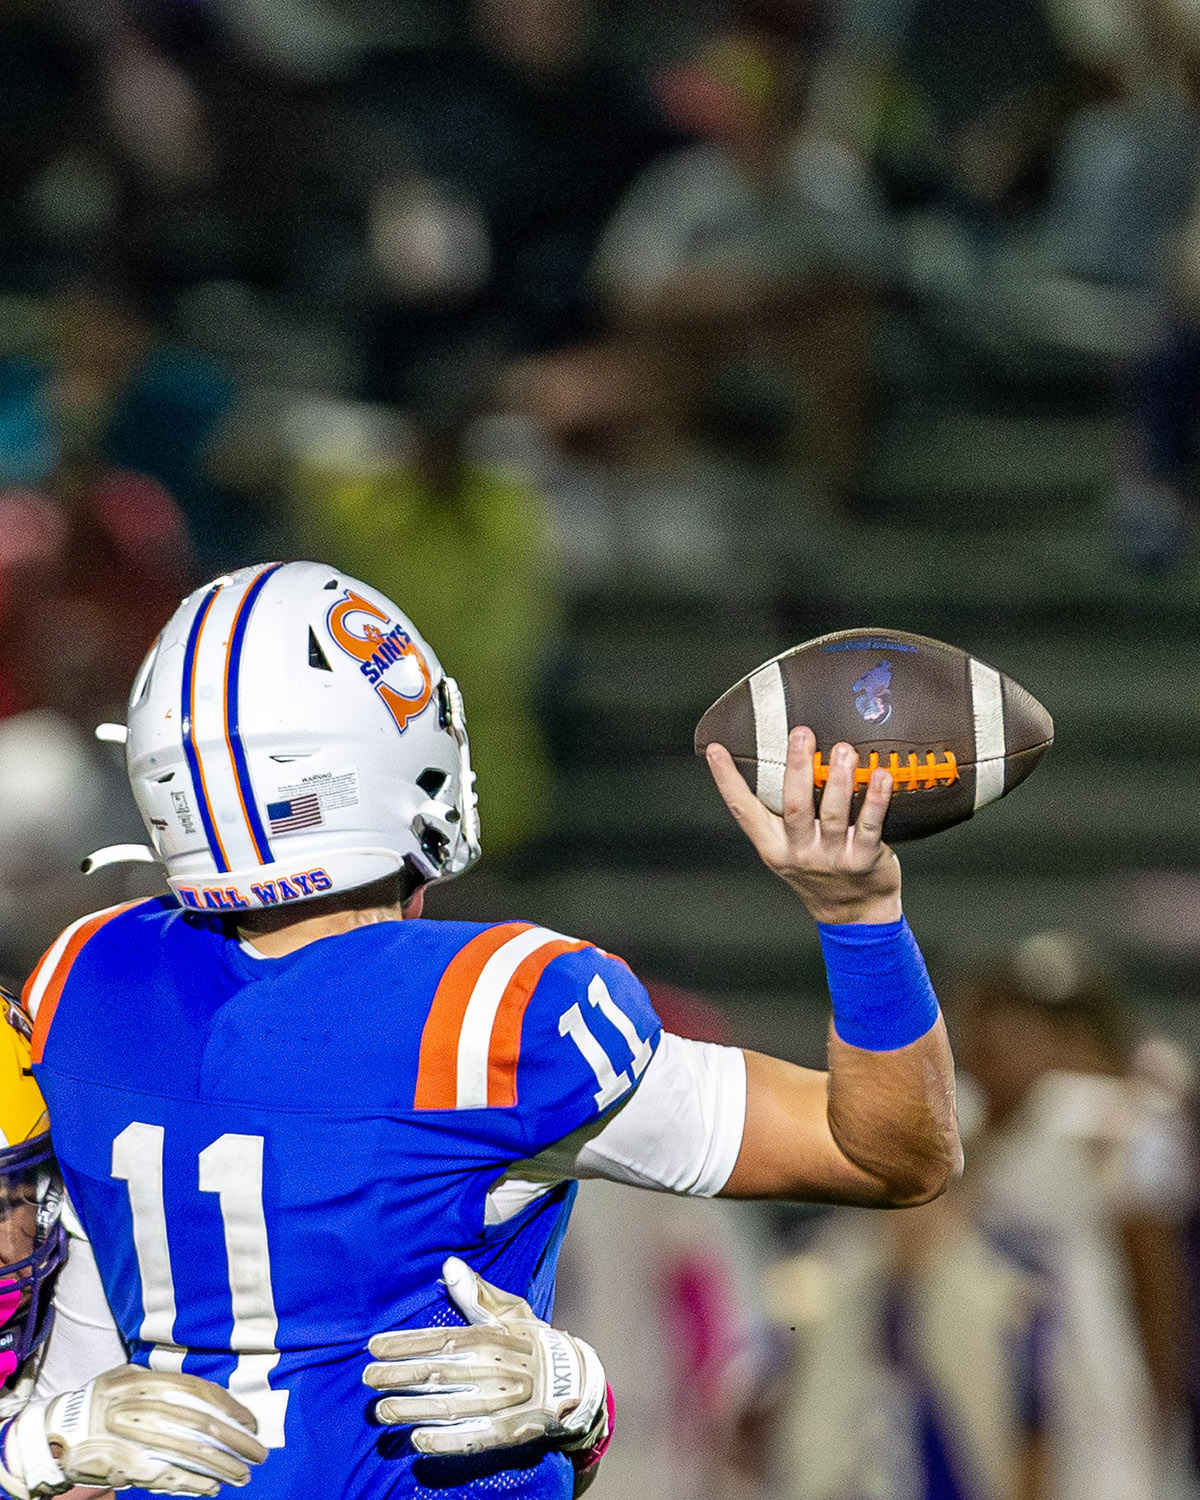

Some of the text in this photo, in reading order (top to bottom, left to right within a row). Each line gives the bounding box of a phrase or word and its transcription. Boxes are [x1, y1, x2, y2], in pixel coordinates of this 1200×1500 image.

[360, 623, 411, 685] SAINTS
[203, 887, 250, 909] ALL
[250, 867, 333, 907] WAYS
[558, 973, 654, 1114] 11
[110, 1121, 290, 1449] 11
[544, 1329, 572, 1398] NXTRND
